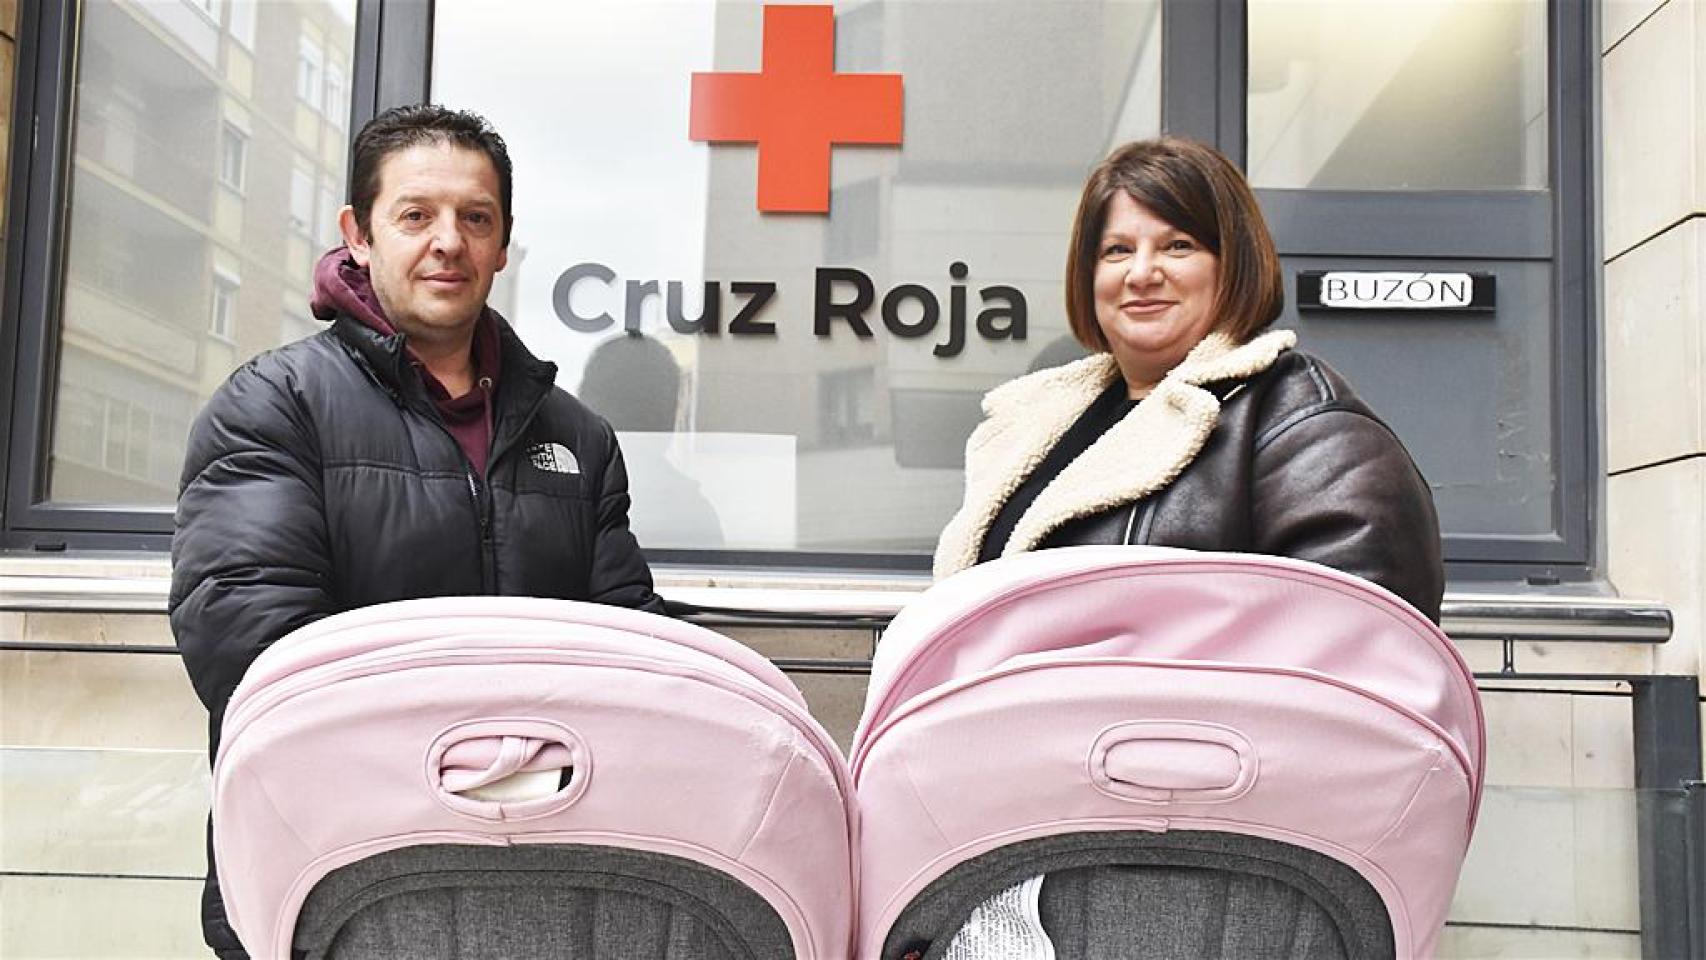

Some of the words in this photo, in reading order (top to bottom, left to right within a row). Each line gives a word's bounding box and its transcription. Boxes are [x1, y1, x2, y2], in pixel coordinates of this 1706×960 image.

[553, 262, 777, 335] Cruz
[814, 261, 1028, 358] Roja
[1327, 272, 1465, 302] BUZÓN
